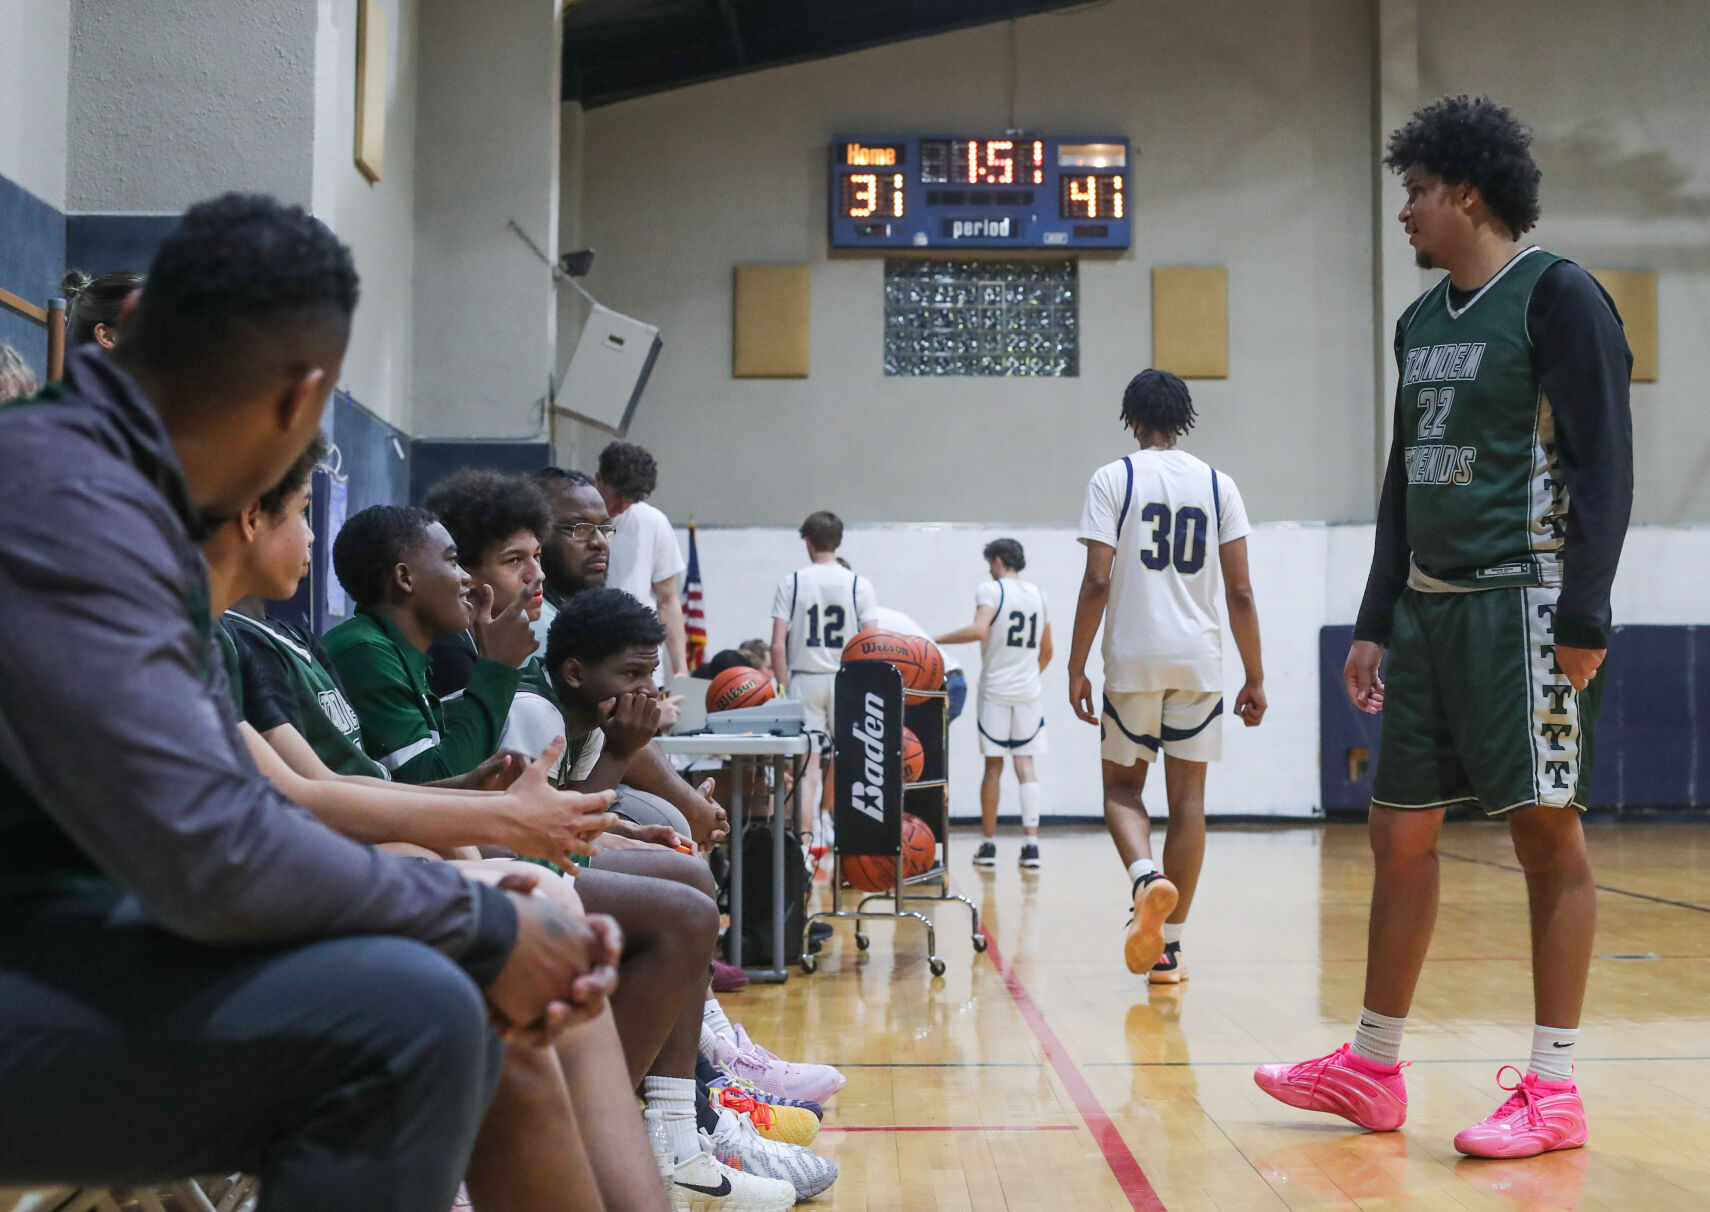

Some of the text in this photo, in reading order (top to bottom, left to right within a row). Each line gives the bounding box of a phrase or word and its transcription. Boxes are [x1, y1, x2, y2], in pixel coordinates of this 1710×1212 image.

[847, 143, 897, 166] Home
[850, 174, 904, 217] 31
[1070, 175, 1124, 218] 41
[952, 217, 1010, 239] period
[1402, 342, 1487, 388] TANDEM
[1417, 386, 1455, 441] 22
[1140, 501, 1208, 575] 30
[806, 604, 846, 648] 12
[1006, 610, 1038, 649] 21
[861, 641, 910, 657] Wilson
[717, 678, 759, 710] Wilson
[851, 691, 885, 823] Baden
